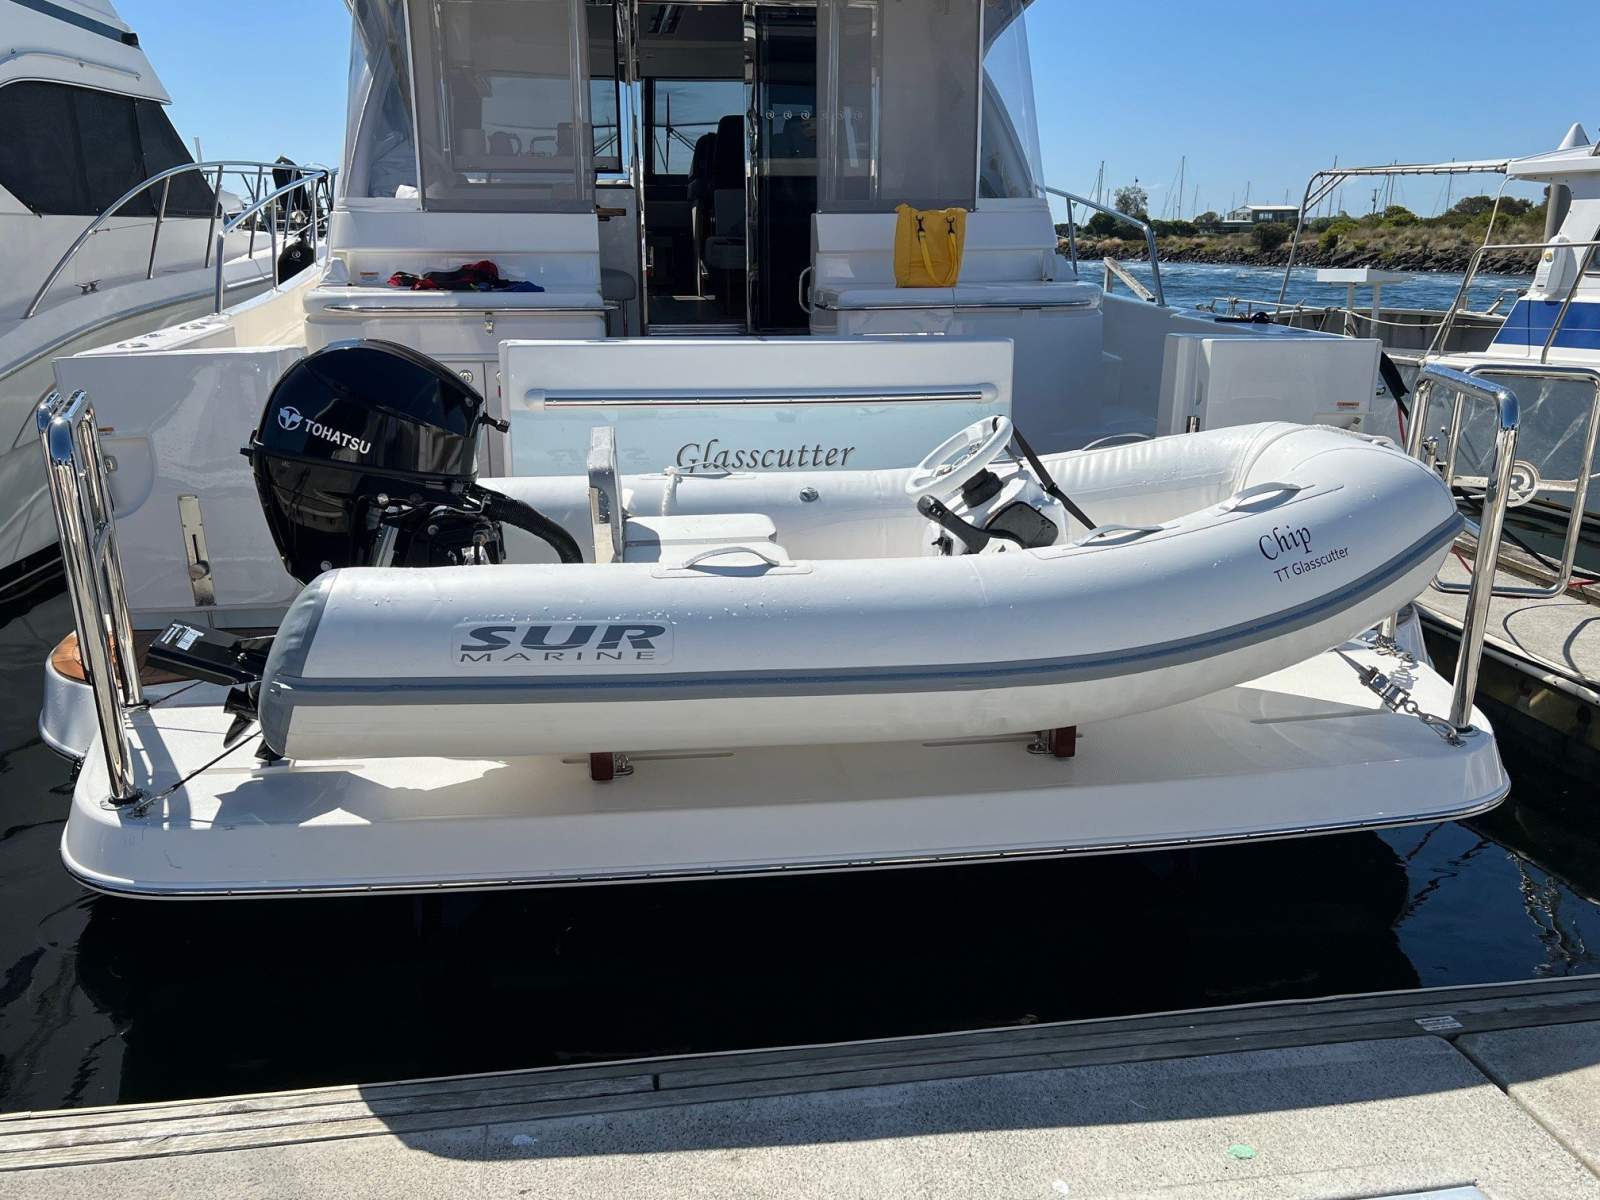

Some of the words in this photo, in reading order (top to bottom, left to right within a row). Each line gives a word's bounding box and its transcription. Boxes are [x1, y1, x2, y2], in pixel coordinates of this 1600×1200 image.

[304, 419, 371, 454] TOHATSU
[676, 438, 855, 473] Glasscutter
[1259, 524, 1312, 560] Chip
[1273, 566, 1290, 582] TT
[1291, 547, 1349, 575] Glasscutter
[460, 625, 666, 651] SUR
[460, 651, 655, 662] MARINE
